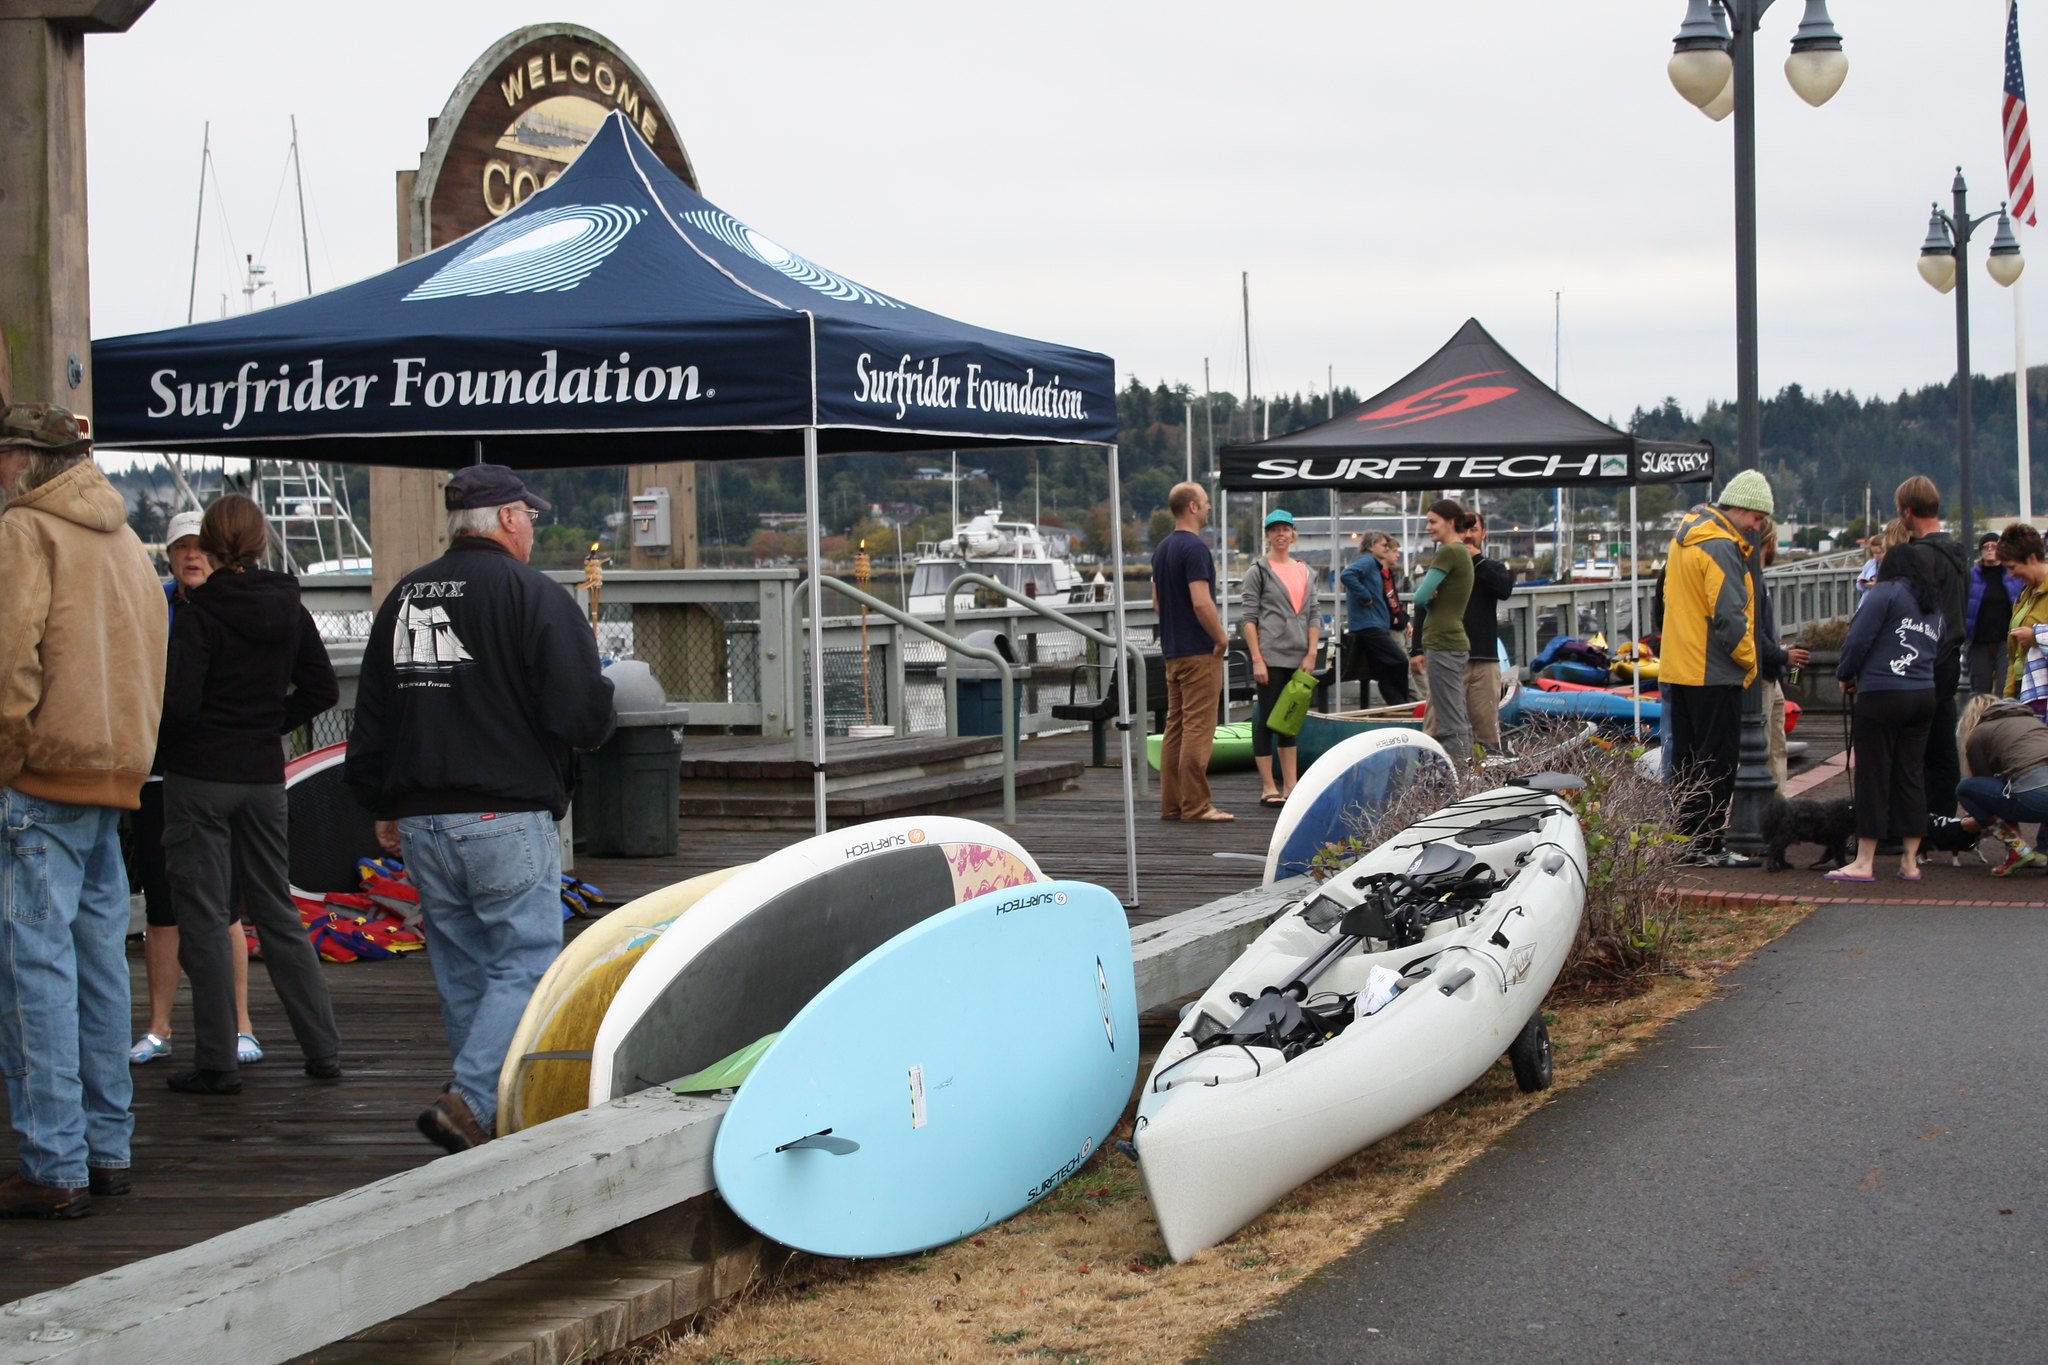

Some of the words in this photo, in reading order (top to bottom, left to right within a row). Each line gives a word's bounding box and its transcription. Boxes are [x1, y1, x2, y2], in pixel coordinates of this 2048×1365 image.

[501, 52, 658, 144] WELCOME
[482, 159, 560, 217] CO
[148, 359, 378, 430] Surfrider
[854, 352, 960, 420] Surfrider
[1251, 453, 1599, 480] SURFTECH
[1640, 451, 1709, 473] SURFTECH
[398, 580, 466, 602] LYNX
[1901, 617, 1924, 633] Shark
[845, 834, 905, 859] SURFTECH
[996, 893, 1053, 916] SURFTECH
[1027, 1152, 1080, 1202] SURFTECH
